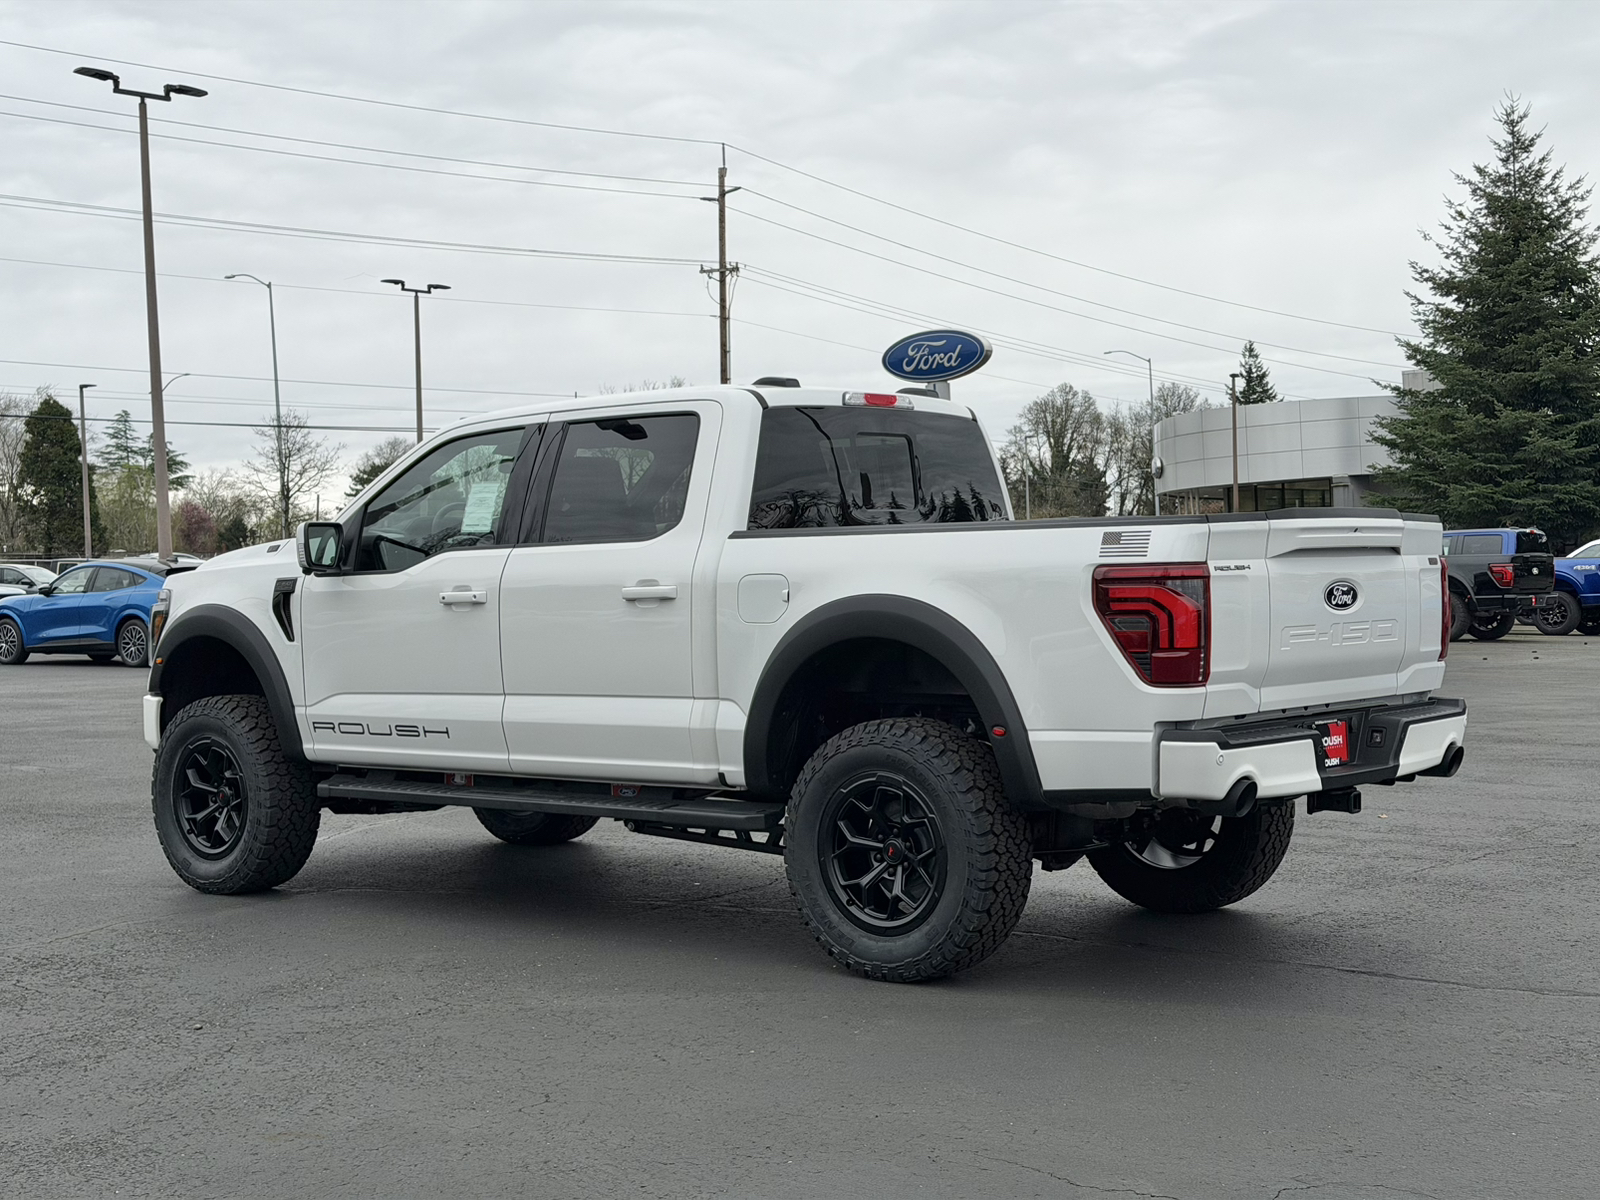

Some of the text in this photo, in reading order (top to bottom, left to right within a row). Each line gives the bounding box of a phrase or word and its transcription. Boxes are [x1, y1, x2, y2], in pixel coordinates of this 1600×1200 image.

[902, 340, 962, 372] Ford
[1331, 586, 1354, 605] Ford
[1281, 619, 1398, 650] F-150
[312, 721, 450, 739] ROUSH
[1322, 734, 1343, 746] OUSH
[1324, 756, 1340, 767] OUSH
